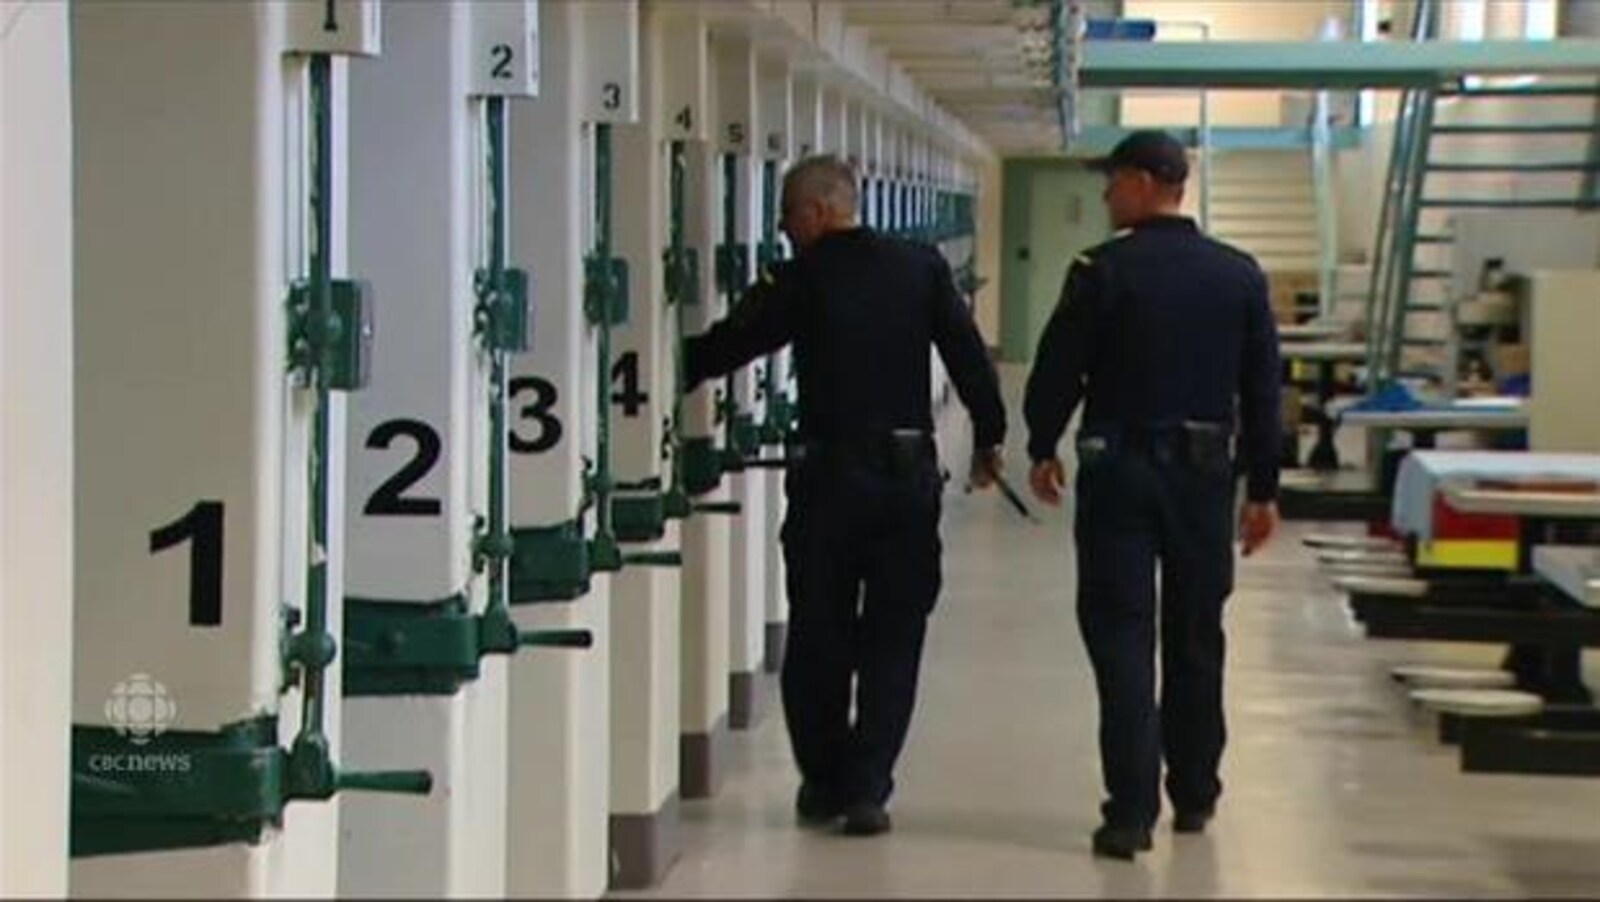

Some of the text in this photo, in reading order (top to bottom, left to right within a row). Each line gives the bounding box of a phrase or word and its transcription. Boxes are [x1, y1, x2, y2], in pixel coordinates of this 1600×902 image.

[490, 45, 513, 79] 2
[603, 83, 621, 109] 3
[676, 105, 691, 130] 4
[728, 123, 743, 143] 5
[611, 351, 648, 418] 4
[508, 377, 562, 453] 3
[364, 419, 442, 516] 2
[149, 501, 225, 626] 1
